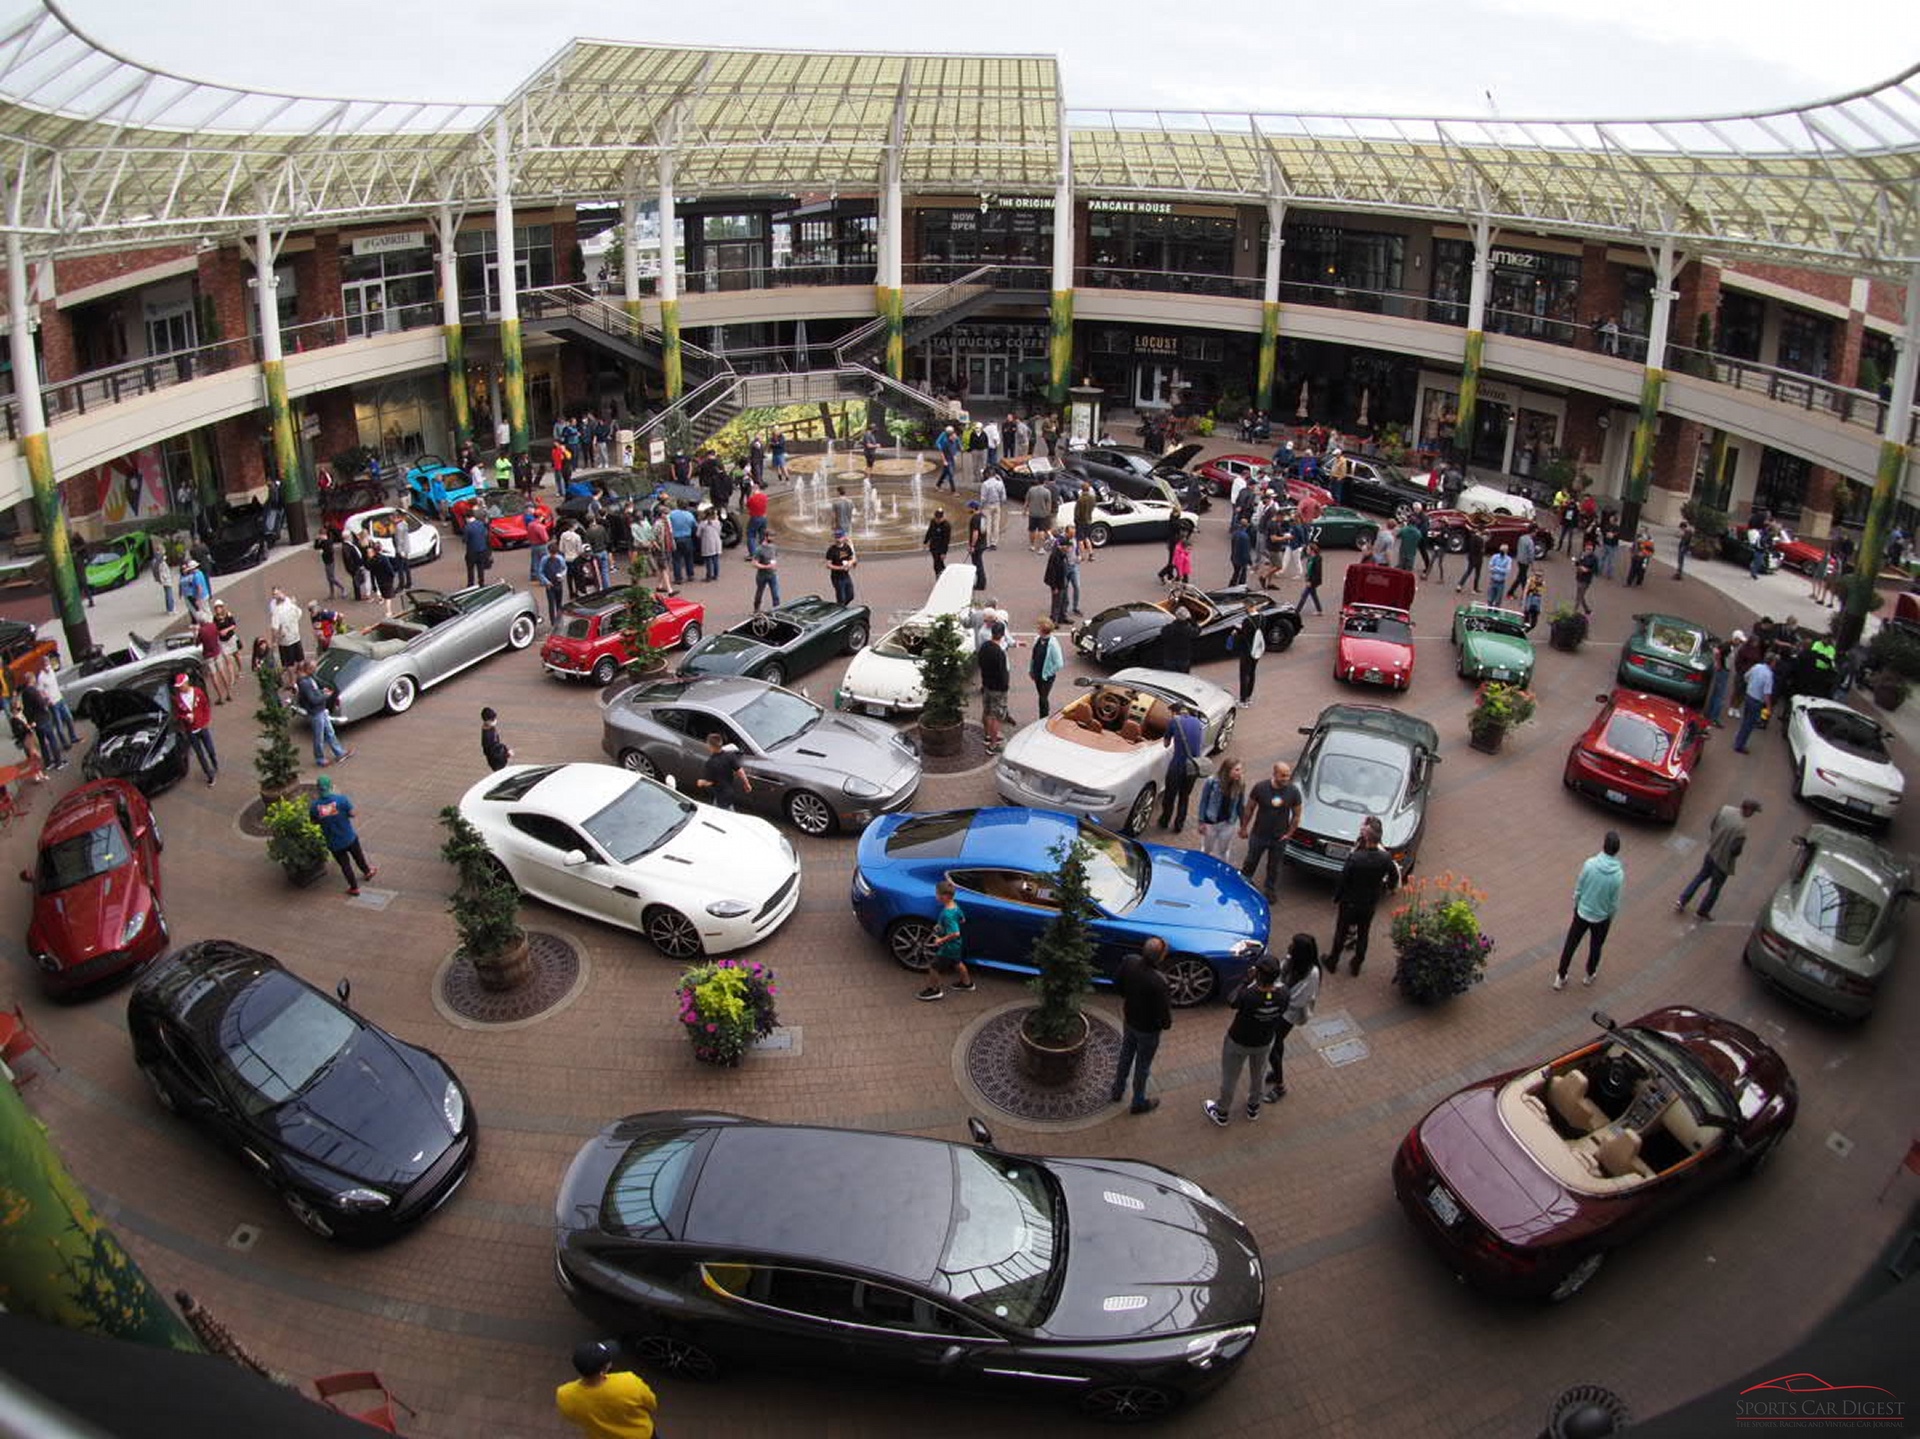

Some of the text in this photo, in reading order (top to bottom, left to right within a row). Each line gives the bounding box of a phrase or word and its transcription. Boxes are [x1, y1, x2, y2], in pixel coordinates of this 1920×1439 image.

[999, 198, 1056, 208] THE ORIGINA
[1088, 200, 1172, 213] PANCAKE HOUSE
[951, 213, 976, 221] NOW
[951, 222, 976, 231] OPEN
[1487, 250, 1534, 268] umiez
[1135, 335, 1177, 349] LOCUST
